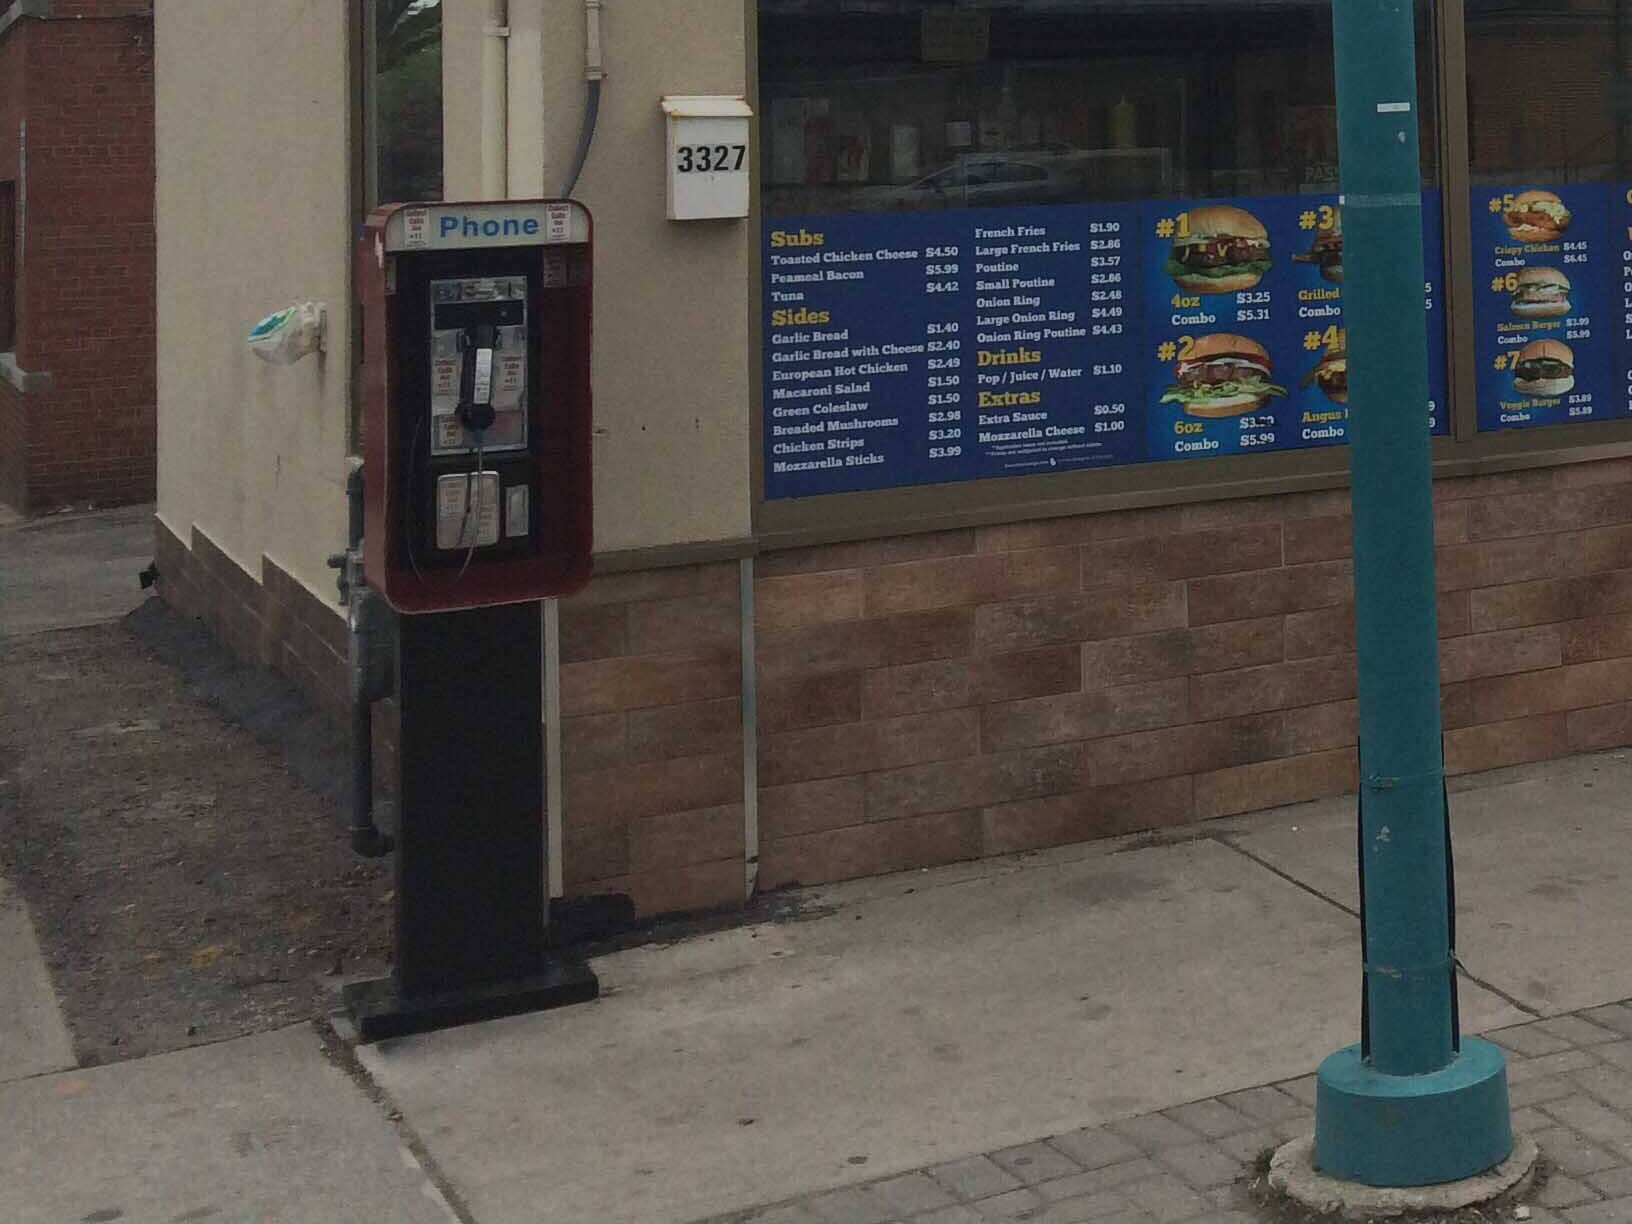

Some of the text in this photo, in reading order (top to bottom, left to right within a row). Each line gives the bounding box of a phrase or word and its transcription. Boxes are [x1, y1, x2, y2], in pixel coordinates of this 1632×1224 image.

[678, 145, 746, 173] 3327
[1488, 193, 1514, 213] #5
[440, 215, 540, 238] Phone
[1155, 213, 1188, 238] #1
[1299, 205, 1334, 230] #3
[771, 229, 824, 247] Subs
[975, 226, 1015, 238] French
[1017, 225, 1046, 236] Fries
[771, 246, 959, 265] Toasted Chicken Cheese $4.50
[975, 241, 1080, 257] Large French Fries
[976, 261, 1019, 273] Poutine
[1495, 257, 1525, 267] Combo
[771, 270, 864, 283] Peameal Bacon
[976, 277, 1055, 290] Small Poutine
[1491, 273, 1518, 292] #6
[771, 281, 959, 302] Tuna $4.42
[1171, 291, 1270, 308] 4oz $3.25
[1298, 288, 1340, 300] Grilled
[976, 295, 1040, 308] Onion Ring
[772, 307, 830, 326] Sides
[976, 310, 1075, 326] Large Onion Ring
[1171, 308, 1270, 325] Combo $5.31
[1298, 305, 1341, 318] Combo
[772, 322, 959, 344] Garlic Bread $1.40
[977, 327, 1086, 343] Onion Ring Poutine
[1303, 326, 1339, 350] #4
[1497, 334, 1527, 344] Combo
[772, 340, 960, 362] Garlic Bread with Cheese $2.40
[977, 347, 1041, 366] Drinks
[1157, 336, 1194, 362] #2
[773, 362, 908, 381] European Hot Chicken
[977, 364, 1122, 385] Pop Juice Water $1.10
[773, 375, 960, 399] Macaroni Salad $1.50
[773, 393, 960, 417] Green Coleslaw $1.50
[978, 391, 1040, 408] Extras
[978, 403, 1125, 425] Extra Sauce $0.50
[1302, 412, 1342, 423] Angus
[1500, 412, 1530, 423] Combo
[773, 418, 899, 436] Breaded Mushrooms
[979, 420, 1125, 443] Mozzarella Cheese $1.00
[1174, 421, 1203, 434] 6oz
[1302, 426, 1344, 439] Combo
[773, 428, 961, 454] Chicken Strips $3.20
[1174, 433, 1275, 452] Combo $5.99
[773, 446, 962, 473] Mozzarella Sticks $3.99
